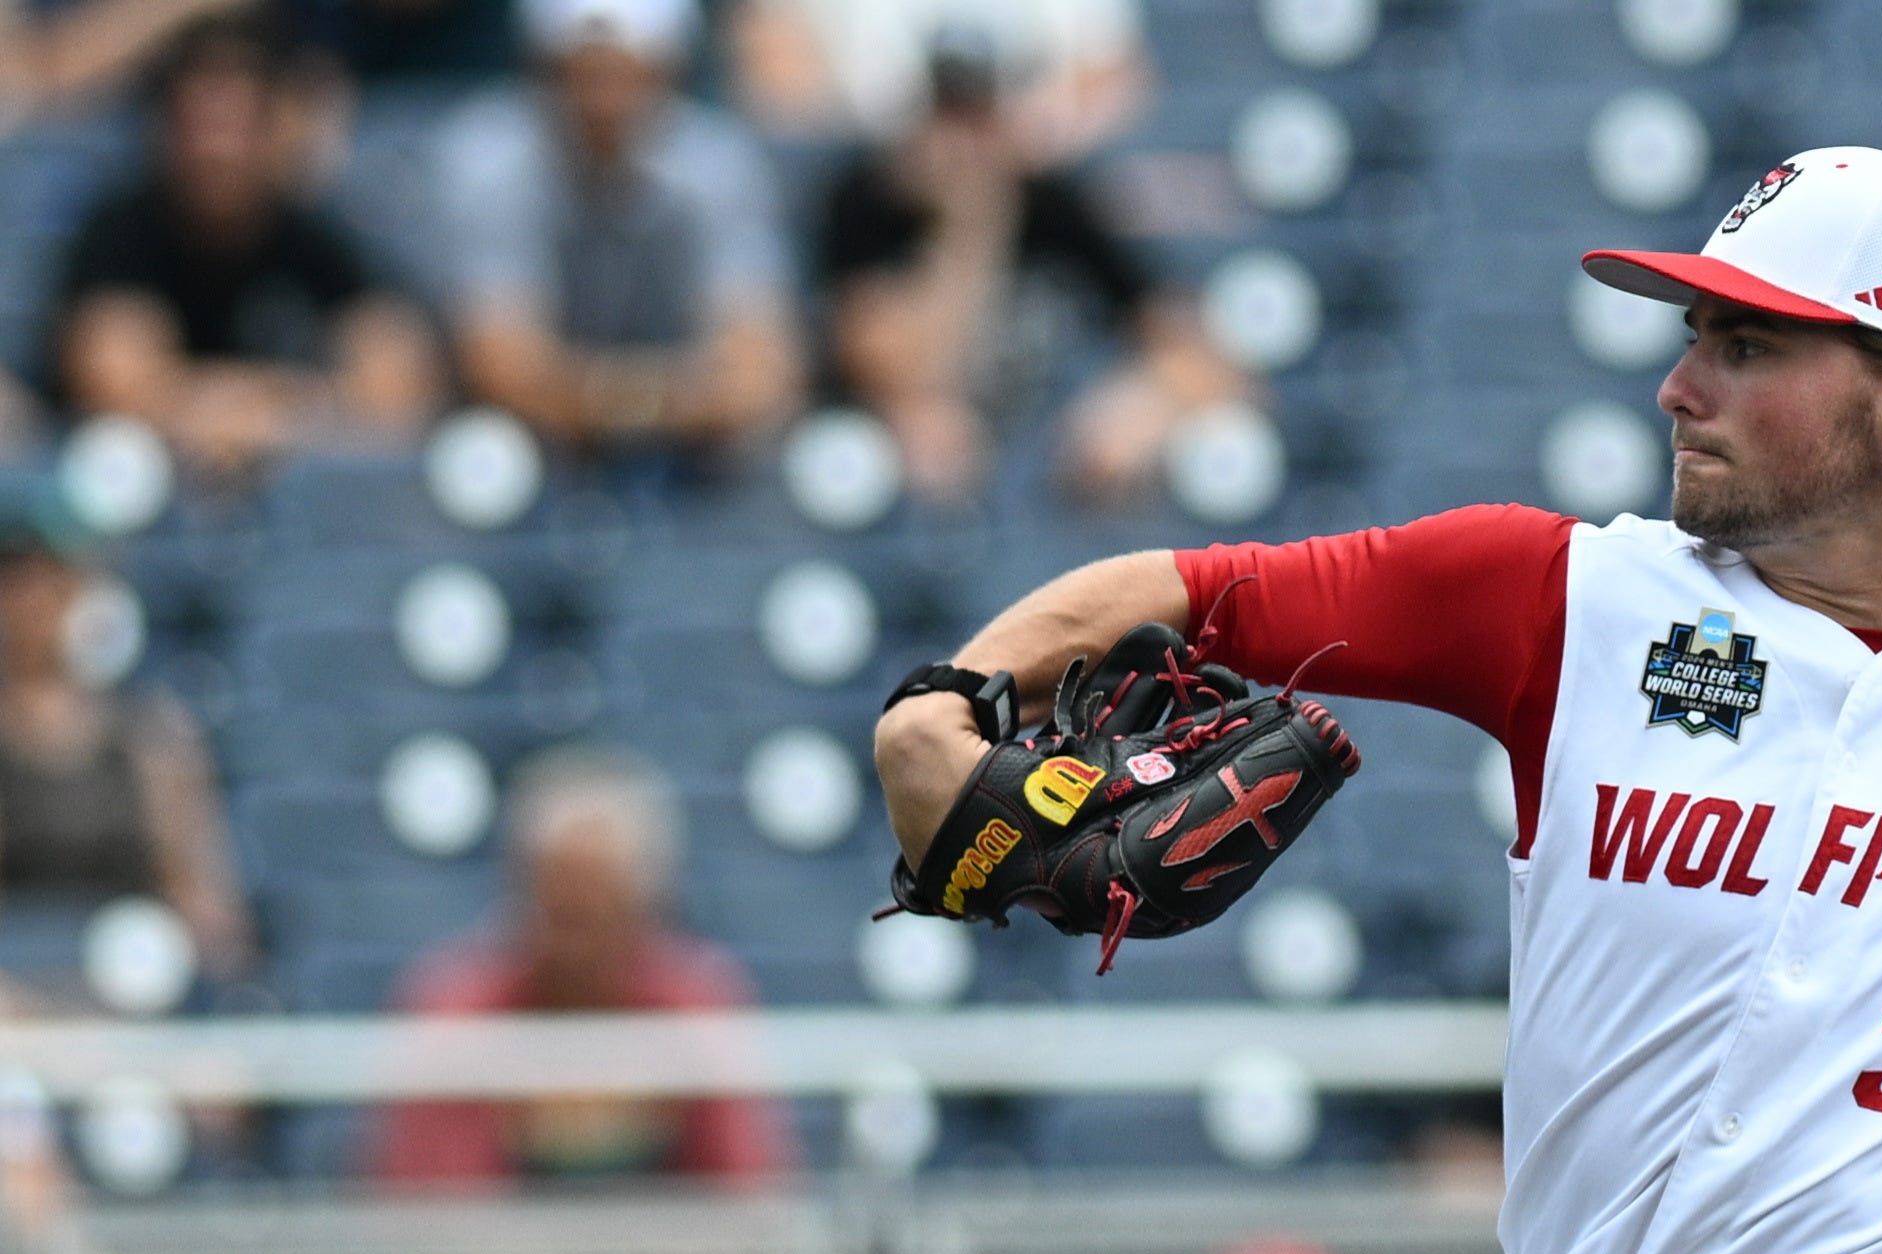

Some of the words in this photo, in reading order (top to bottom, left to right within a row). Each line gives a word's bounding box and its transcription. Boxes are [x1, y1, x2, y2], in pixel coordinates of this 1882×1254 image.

[1671, 661, 1739, 687] COLLEGE
[1645, 674, 1701, 699] WORLD
[1701, 685, 1758, 709] SERIES
[1681, 700, 1718, 712] OMAHA
[943, 818, 1023, 914] Wilson
